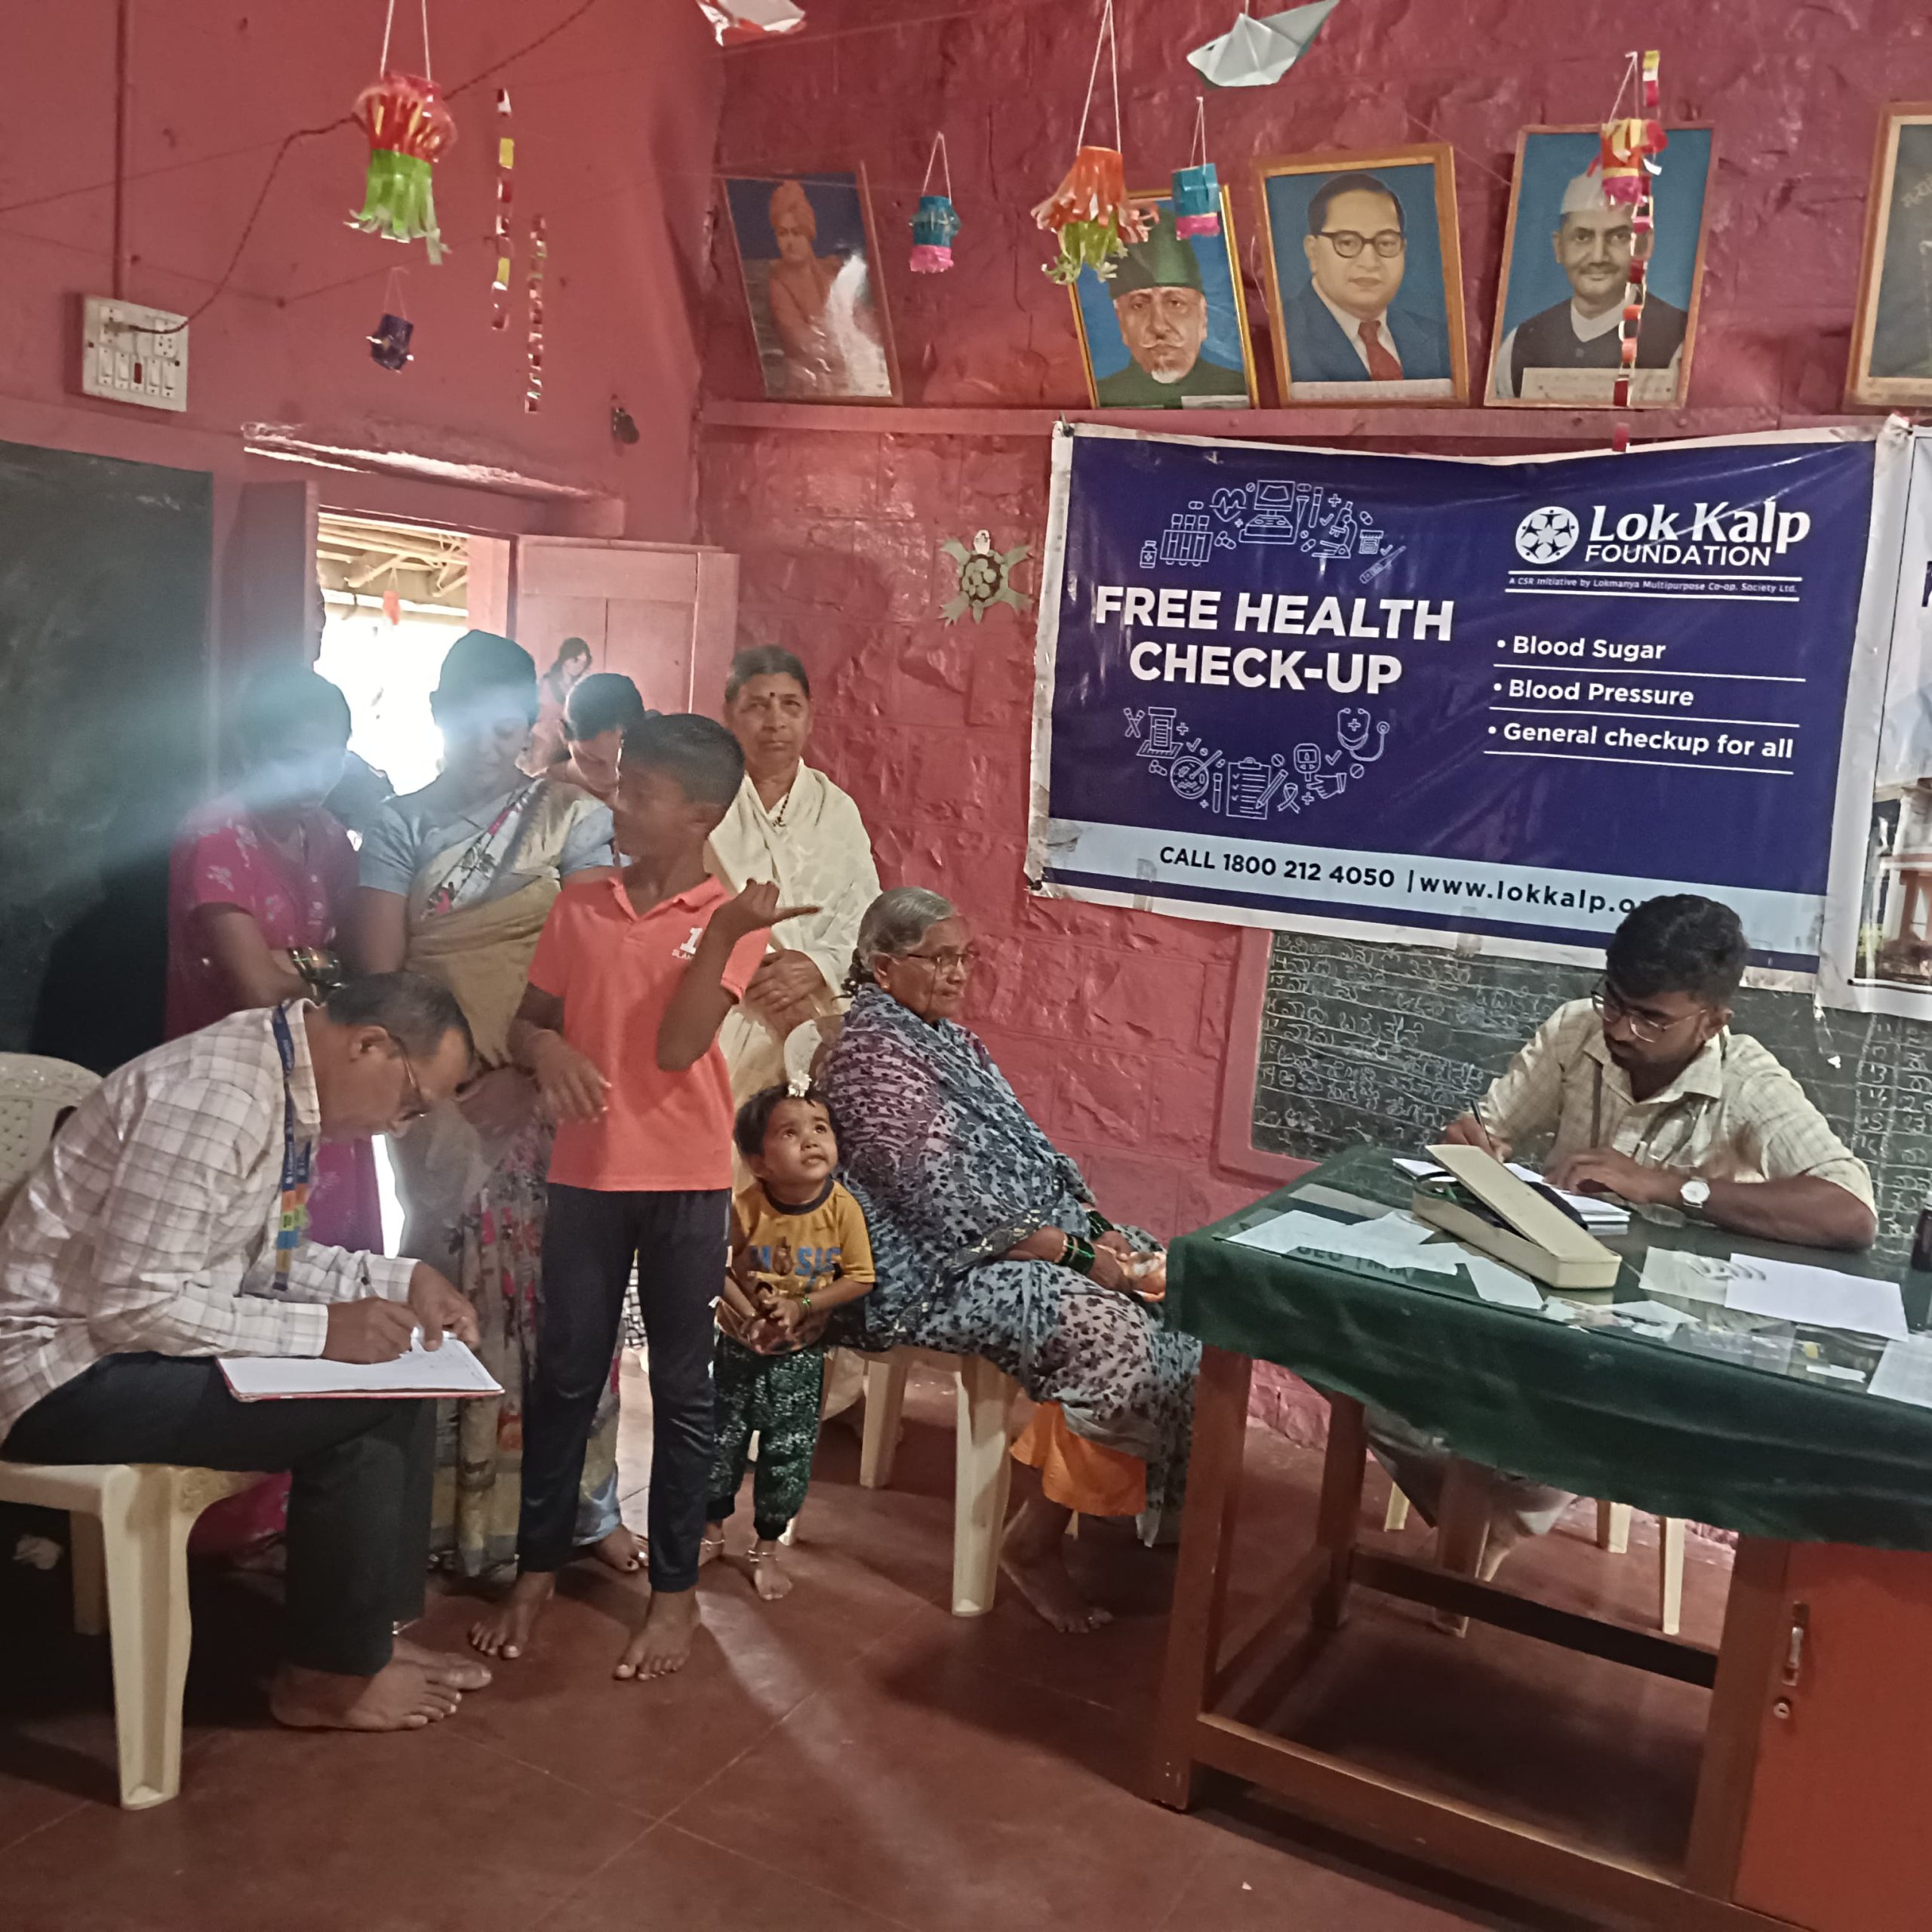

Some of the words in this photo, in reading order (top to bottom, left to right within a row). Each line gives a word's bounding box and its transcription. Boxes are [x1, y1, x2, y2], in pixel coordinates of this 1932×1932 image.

[1589, 503, 1681, 543] Lok
[1693, 500, 1810, 554] Kalp
[1585, 544, 1771, 567] FOUNDATION
[1518, 577, 1534, 586] CSR
[1537, 577, 1577, 586] Initiative
[1580, 578, 1591, 588] by
[1593, 579, 1640, 589] Lokmanya
[1643, 580, 1706, 592] Multipurpose
[1741, 583, 1777, 594] Society
[1779, 584, 1797, 593] Ltd.
[1096, 586, 1222, 630] FREE
[1234, 592, 1454, 641] HEALTH
[1513, 635, 1586, 657] Blood
[1592, 638, 1666, 663] Sugar
[1130, 641, 1402, 694] CHECK-UP
[1509, 678, 1580, 700] Blood
[1588, 683, 1694, 706] Pressure
[1503, 722, 1598, 744] General
[1604, 728, 1709, 755] checkup
[1717, 734, 1755, 755] for
[1761, 738, 1794, 758] all
[1160, 846, 1215, 869] CALL
[1223, 854, 1276, 876] 1800
[1284, 860, 1321, 881] 212
[1329, 866, 1395, 888] 4050
[1420, 877, 1639, 914] www.lokkalp.o
[680, 928, 703, 955] 1
